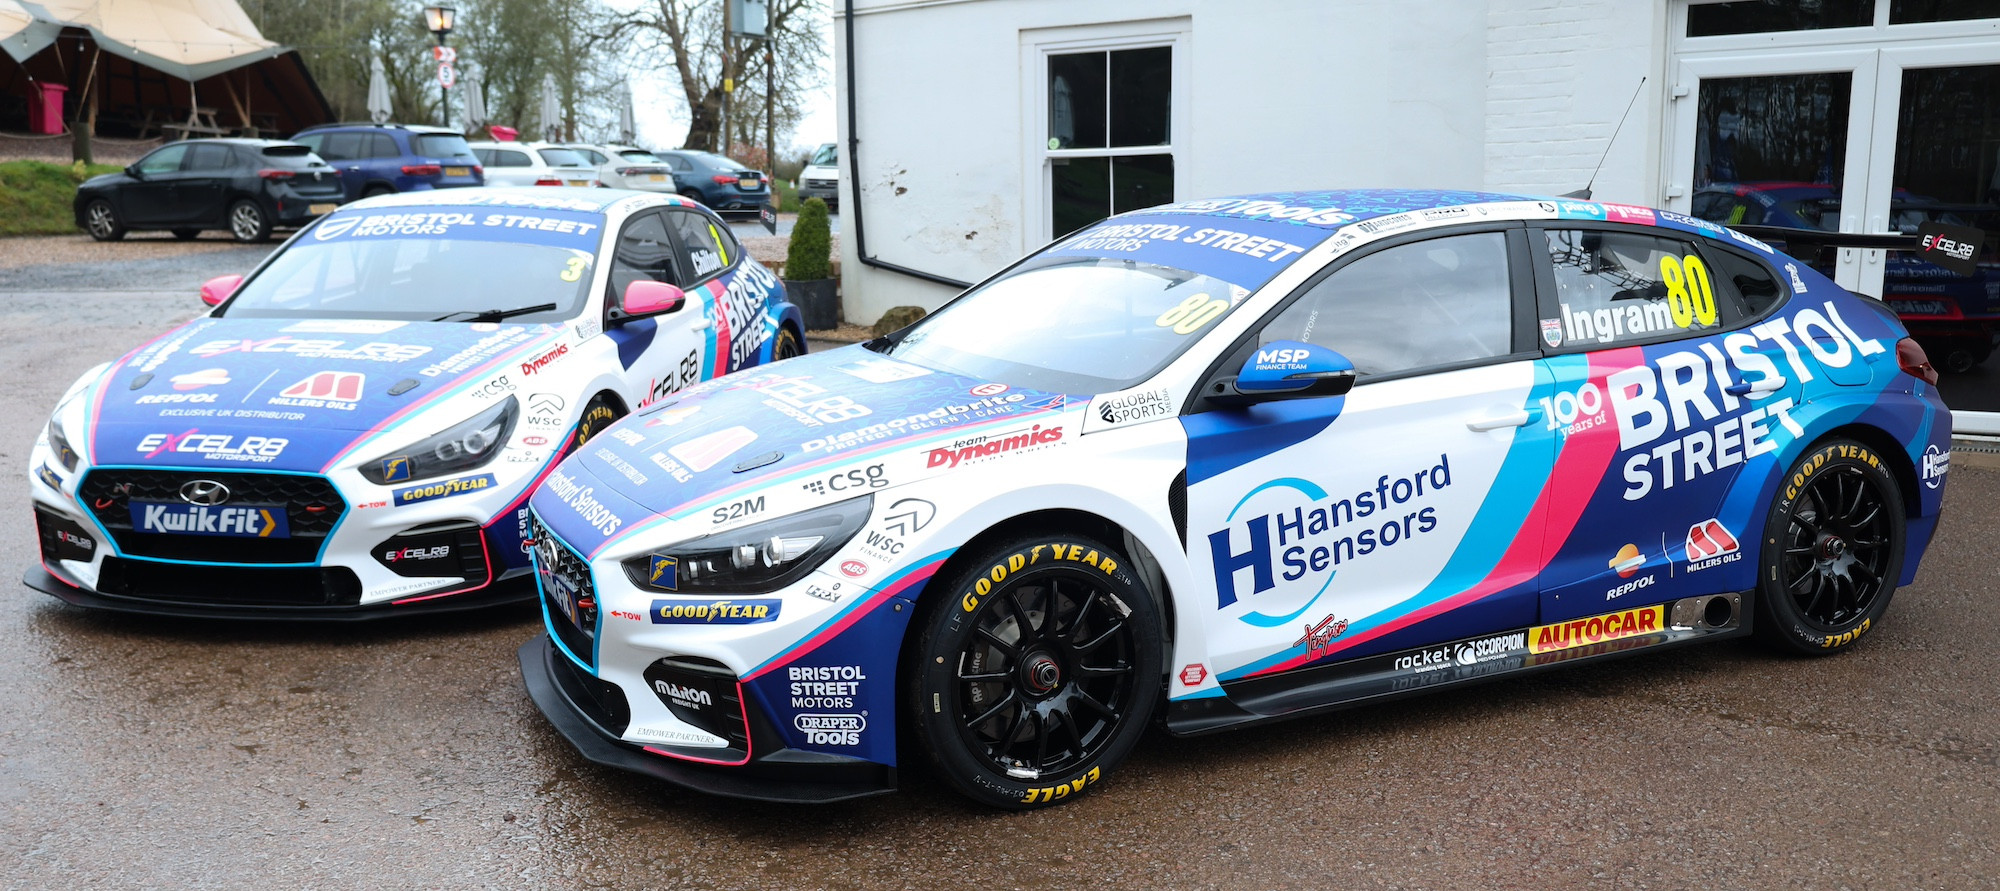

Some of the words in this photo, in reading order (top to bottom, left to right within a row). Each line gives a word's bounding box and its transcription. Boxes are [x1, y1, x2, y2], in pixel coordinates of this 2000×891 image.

[352, 223, 449, 237] MOTORS
[361, 213, 476, 227] BRISTOL
[483, 214, 597, 236] STREET
[1094, 223, 1190, 241] BRISTOL
[1183, 228, 1305, 263] STREET
[1922, 234, 1975, 257] EXCELR8
[560, 256, 586, 282] 3
[1660, 254, 1717, 329] 80
[1155, 292, 1230, 335] 80
[1561, 301, 1674, 343] Ingram
[731, 307, 780, 372] STREET
[521, 343, 569, 376] Dynamics
[1255, 363, 1287, 371] FINANCE
[1256, 349, 1311, 364] MSP
[1606, 301, 1886, 452] BRISTOL
[136, 393, 219, 405] REPSOL
[268, 396, 325, 409] MILLERS
[327, 400, 357, 411] OILS
[1110, 390, 1163, 410] GLOBAL
[1539, 382, 1602, 431] 100
[217, 410, 235, 418] UK
[527, 416, 563, 426] WSC
[801, 392, 1027, 453] Diamondbrite
[1113, 404, 1166, 424] SPORTS
[1560, 416, 1593, 441] years
[1593, 411, 1607, 428] of
[136, 428, 289, 459] EXCELR8
[926, 424, 1063, 469] Dynamics
[952, 435, 988, 449] team
[1622, 396, 1805, 501] STREET
[204, 452, 277, 463] MOTORSPORT
[571, 486, 622, 537] Sensors
[712, 495, 765, 524] S2M
[1276, 453, 1452, 547] Hansford
[144, 505, 260, 534] KwikFit
[385, 546, 450, 562] EXCELR8
[865, 530, 905, 555] WSC
[1281, 505, 1438, 582] Sensors
[842, 563, 867, 575] ABS
[1686, 556, 1722, 574] MILLERS
[1723, 552, 1742, 564] OILS
[1606, 574, 1656, 601] REPSOL
[621, 611, 642, 621] TOW
[1536, 609, 1657, 652] AUTOCAR
[1821, 617, 1872, 648] EAGLE
[1475, 633, 1525, 656] SCORPION
[1395, 646, 1451, 670] rocket
[788, 665, 867, 681] BRISTOL
[790, 681, 859, 697] STREET
[791, 697, 854, 709] MOTORS
[800, 715, 860, 730] DRAPER
[676, 732, 716, 744] PARTNERS
[802, 729, 861, 745] Tools
[1019, 765, 1101, 803] EAGLE
